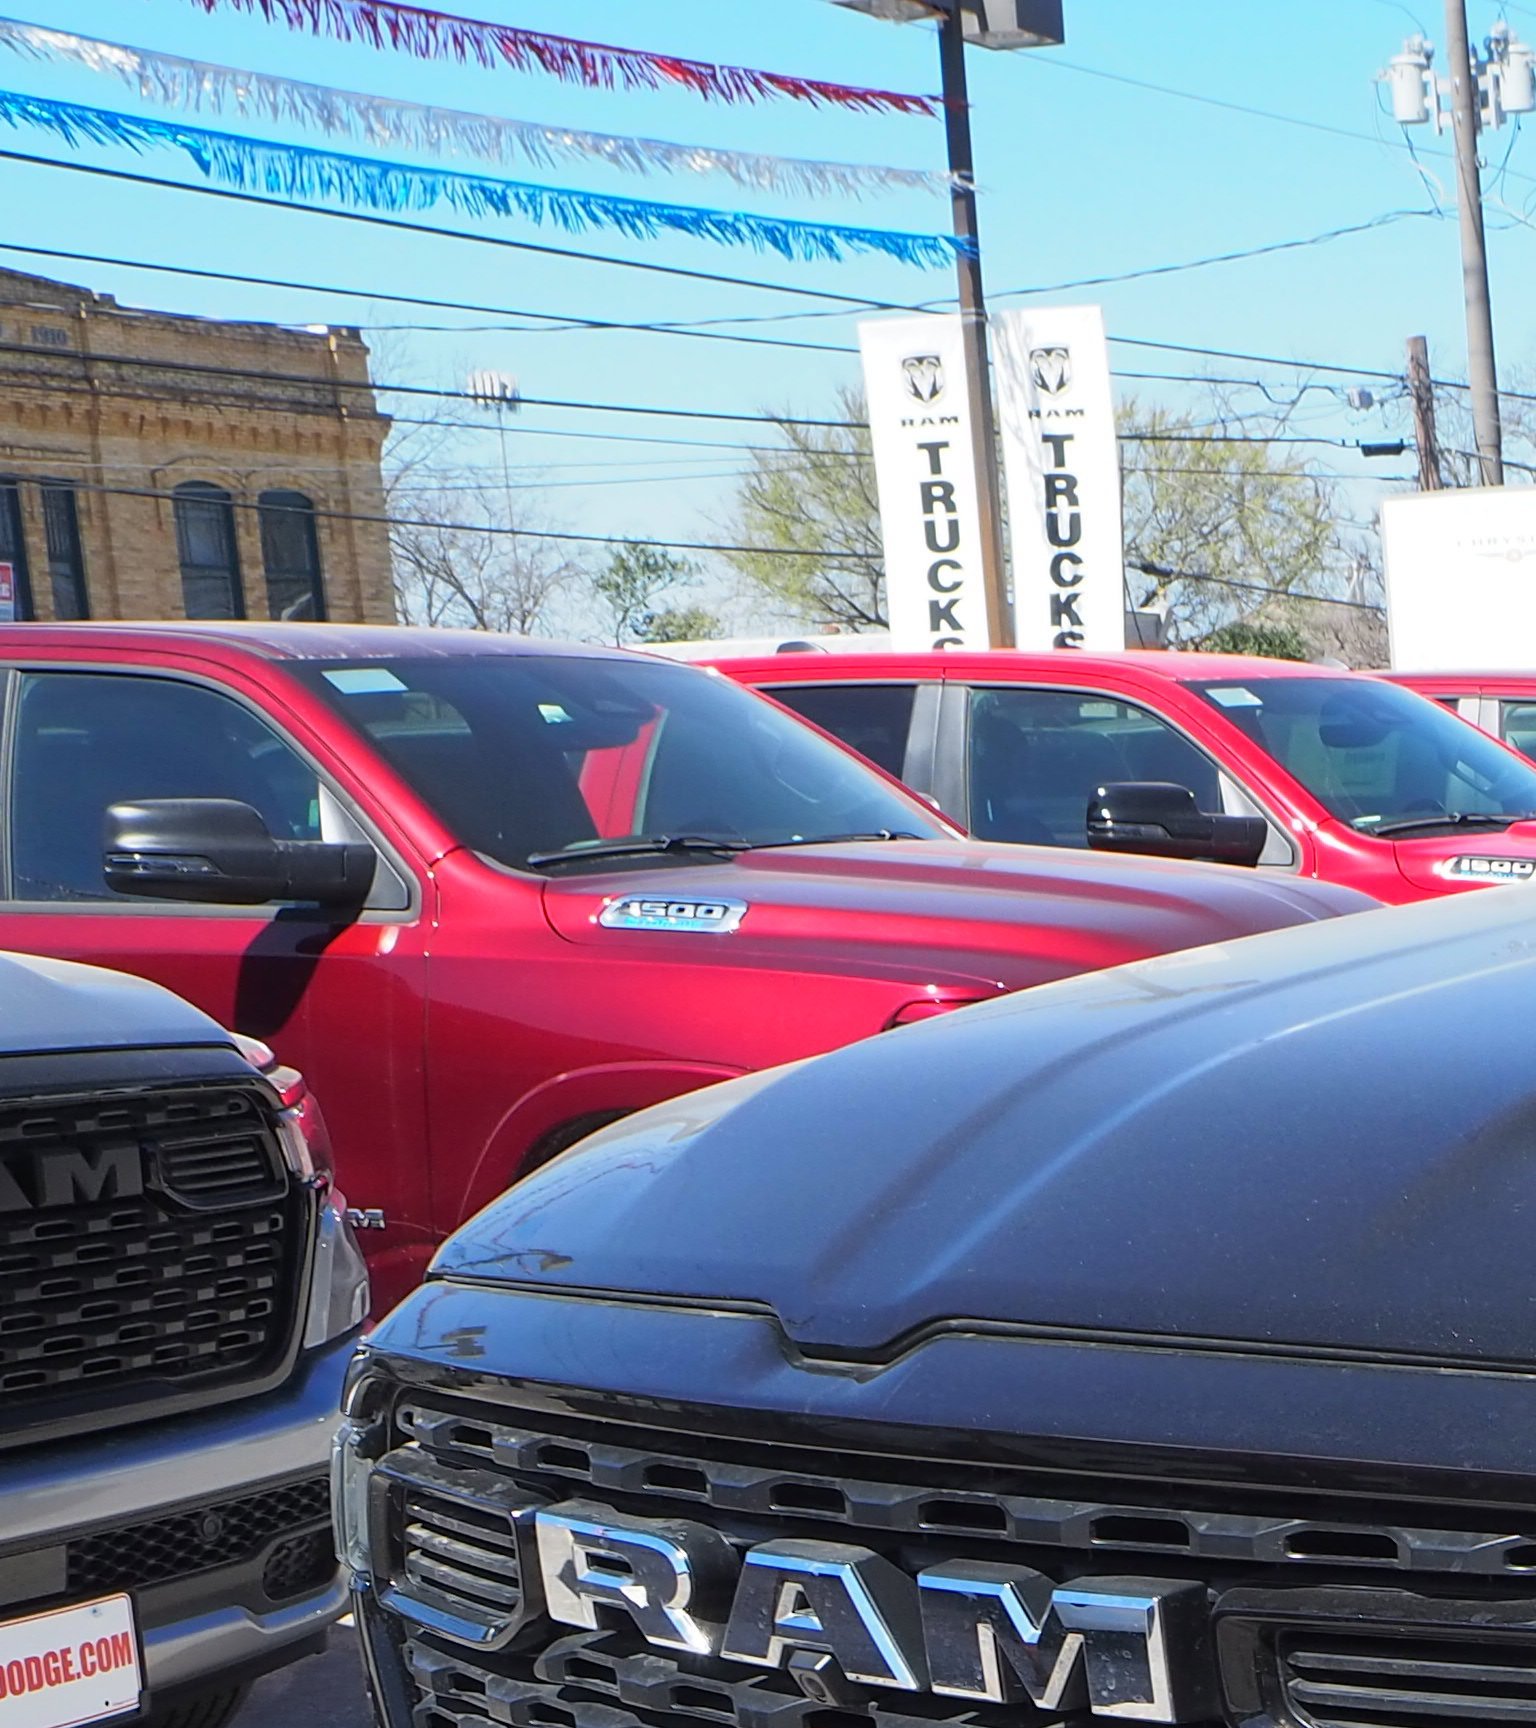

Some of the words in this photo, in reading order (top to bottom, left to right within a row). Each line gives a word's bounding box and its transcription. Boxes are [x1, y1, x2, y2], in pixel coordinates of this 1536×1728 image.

[1027, 408, 1086, 420] RAM
[900, 415, 960, 428] RAM
[534, 1500, 1178, 1725] RAM
